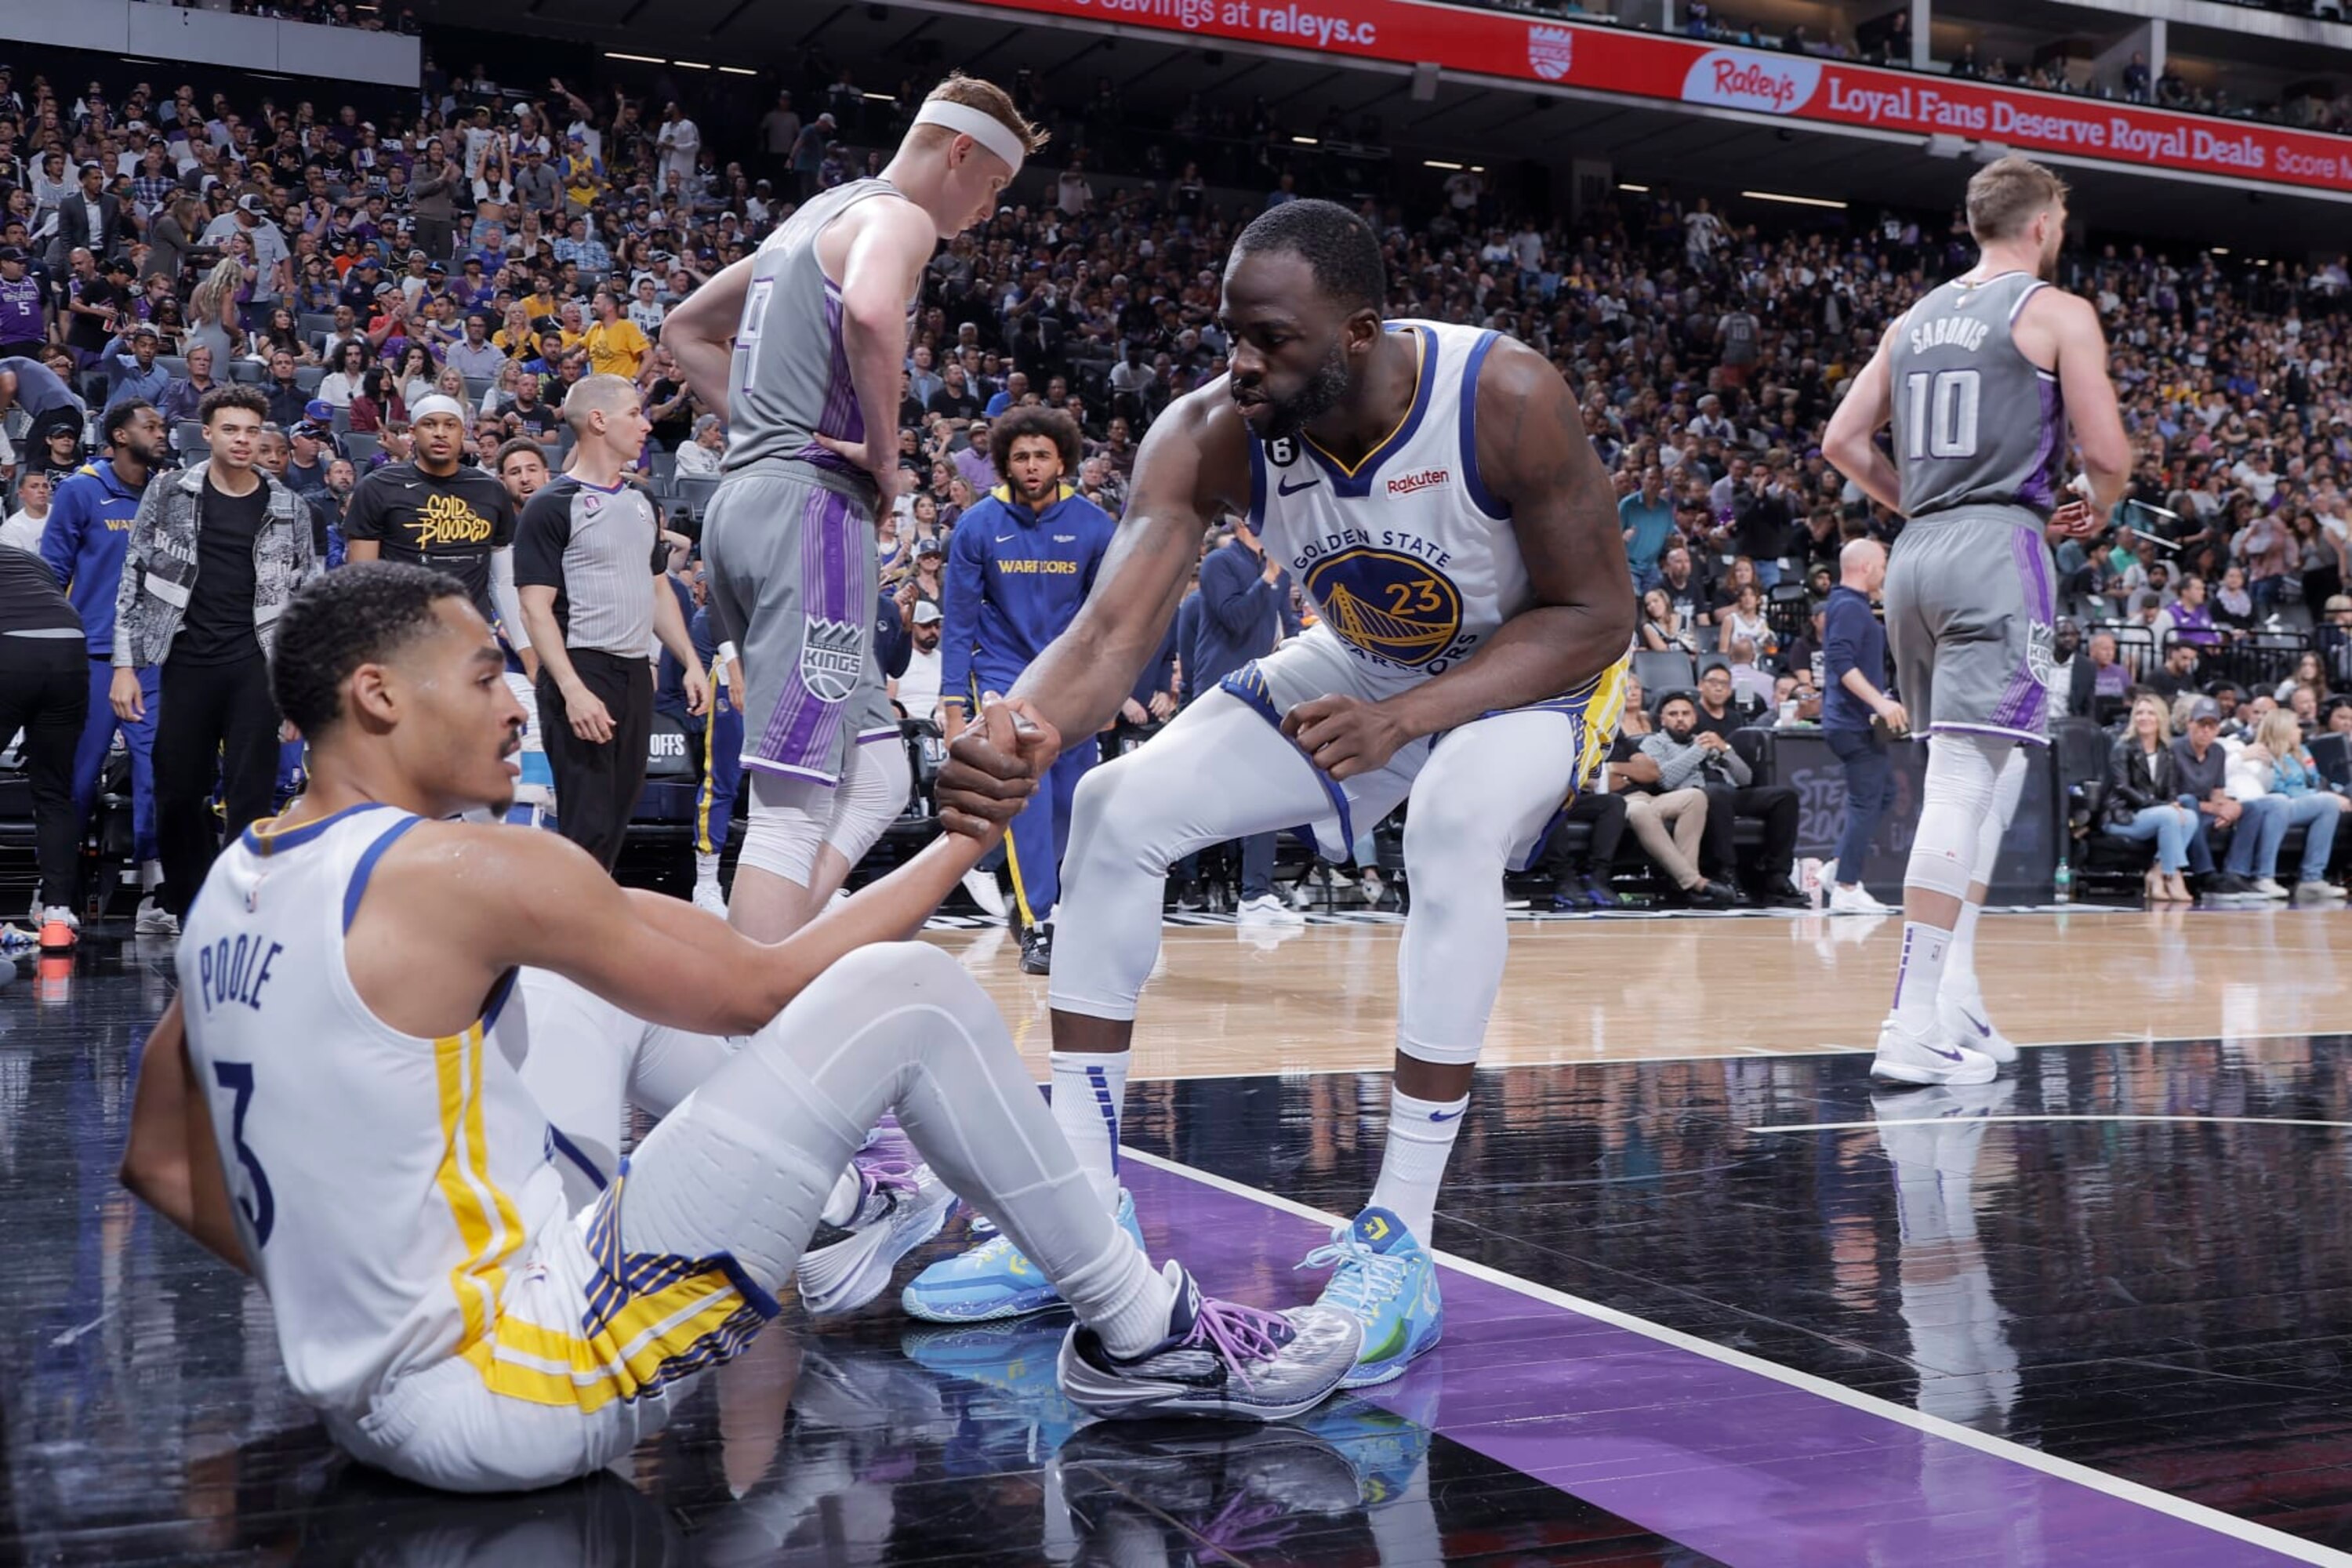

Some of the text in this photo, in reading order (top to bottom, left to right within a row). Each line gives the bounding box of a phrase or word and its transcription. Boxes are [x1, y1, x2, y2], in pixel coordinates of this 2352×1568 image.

[1223, 3, 1251, 26] at
[1258, 5, 1376, 45] raleys.c
[1711, 60, 1795, 110] Raley's
[1828, 78, 1912, 121] Loyal
[1918, 90, 1987, 129] Fans
[1992, 100, 2106, 147] Deserve
[2109, 118, 2187, 159] Royal
[2192, 129, 2265, 168] Deals
[2275, 146, 2337, 179] Score
[1910, 317, 1990, 354] SABONIS
[1907, 368, 1981, 460] 10
[1272, 437, 1294, 463] 6
[1387, 469, 1450, 493] Rakuten
[416, 494, 467, 519] GOLD
[403, 517, 492, 550] BLOODED
[1294, 529, 1451, 569] GOLDEN STATE
[1385, 579, 1442, 615] 23
[802, 649, 861, 675] KINGS
[200, 934, 283, 1013] POOLE
[212, 1061, 275, 1250] 3
